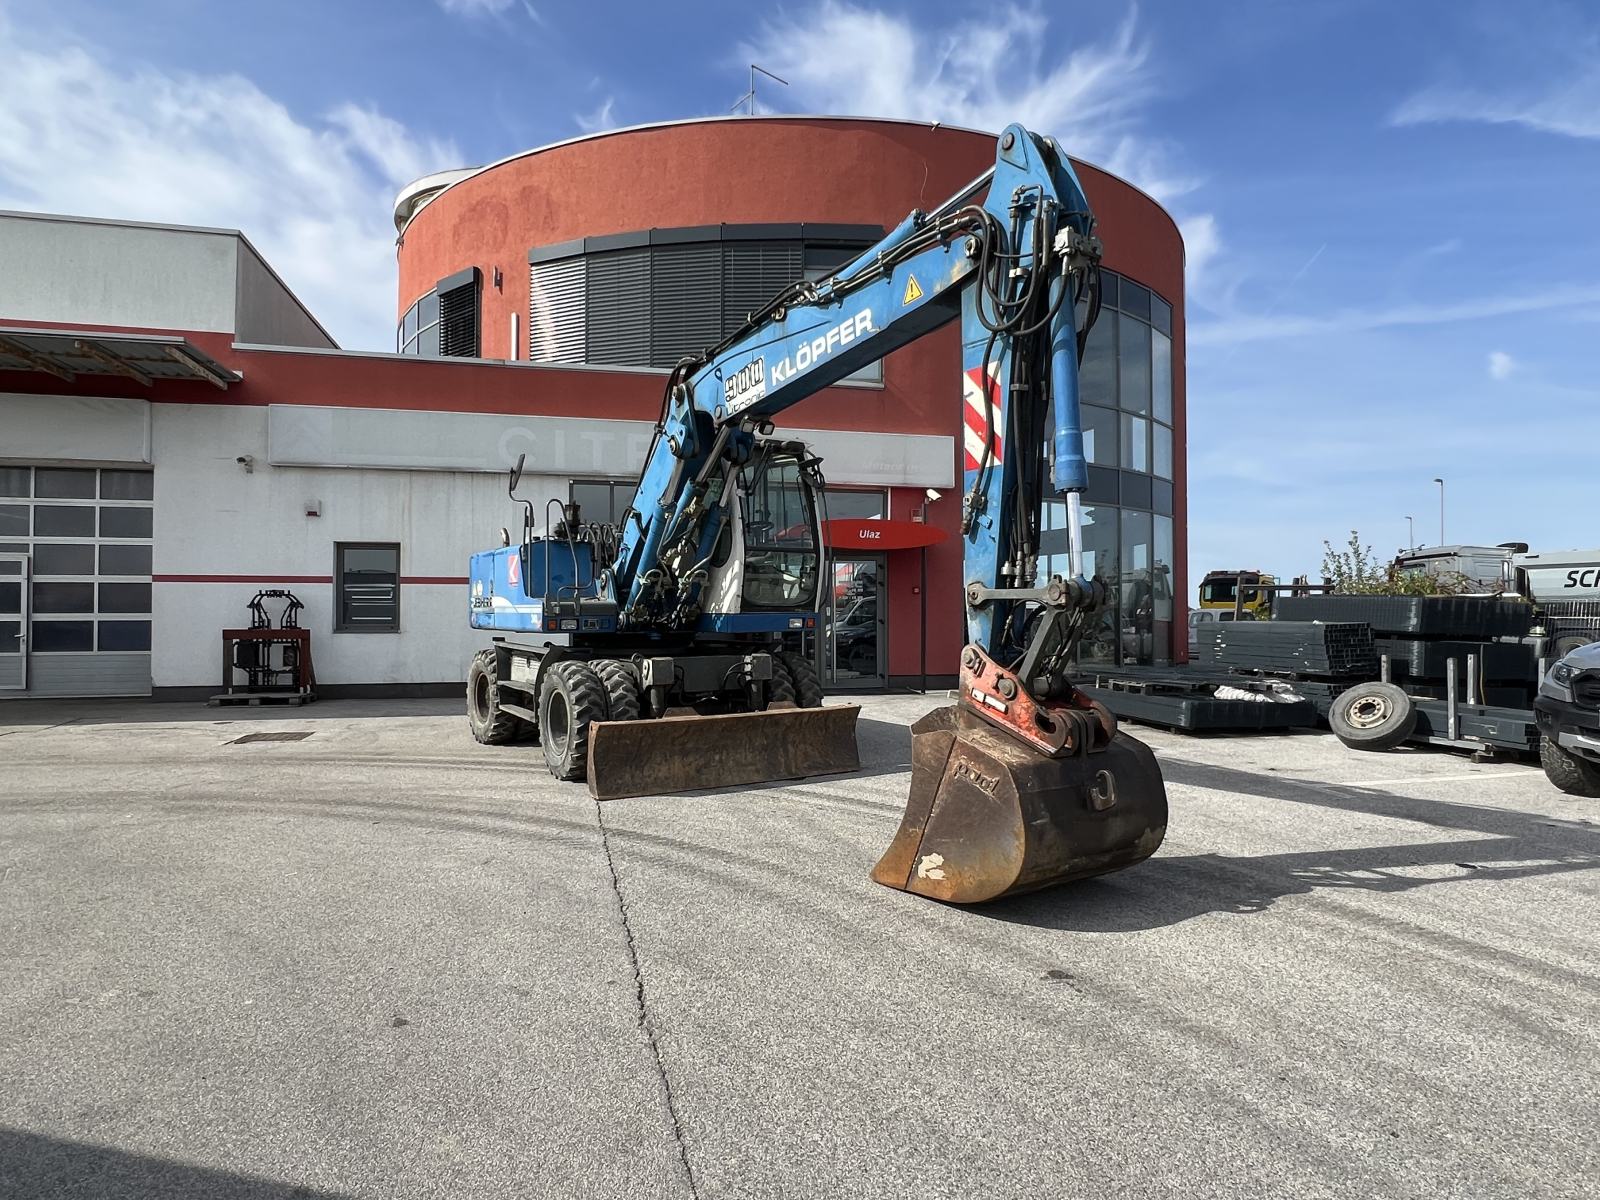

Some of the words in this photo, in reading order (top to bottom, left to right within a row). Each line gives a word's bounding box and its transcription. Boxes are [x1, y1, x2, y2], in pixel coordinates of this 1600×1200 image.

[771, 308, 873, 386] KLÖPFER
[725, 357, 764, 402] 900
[859, 529, 881, 539] Ulaz
